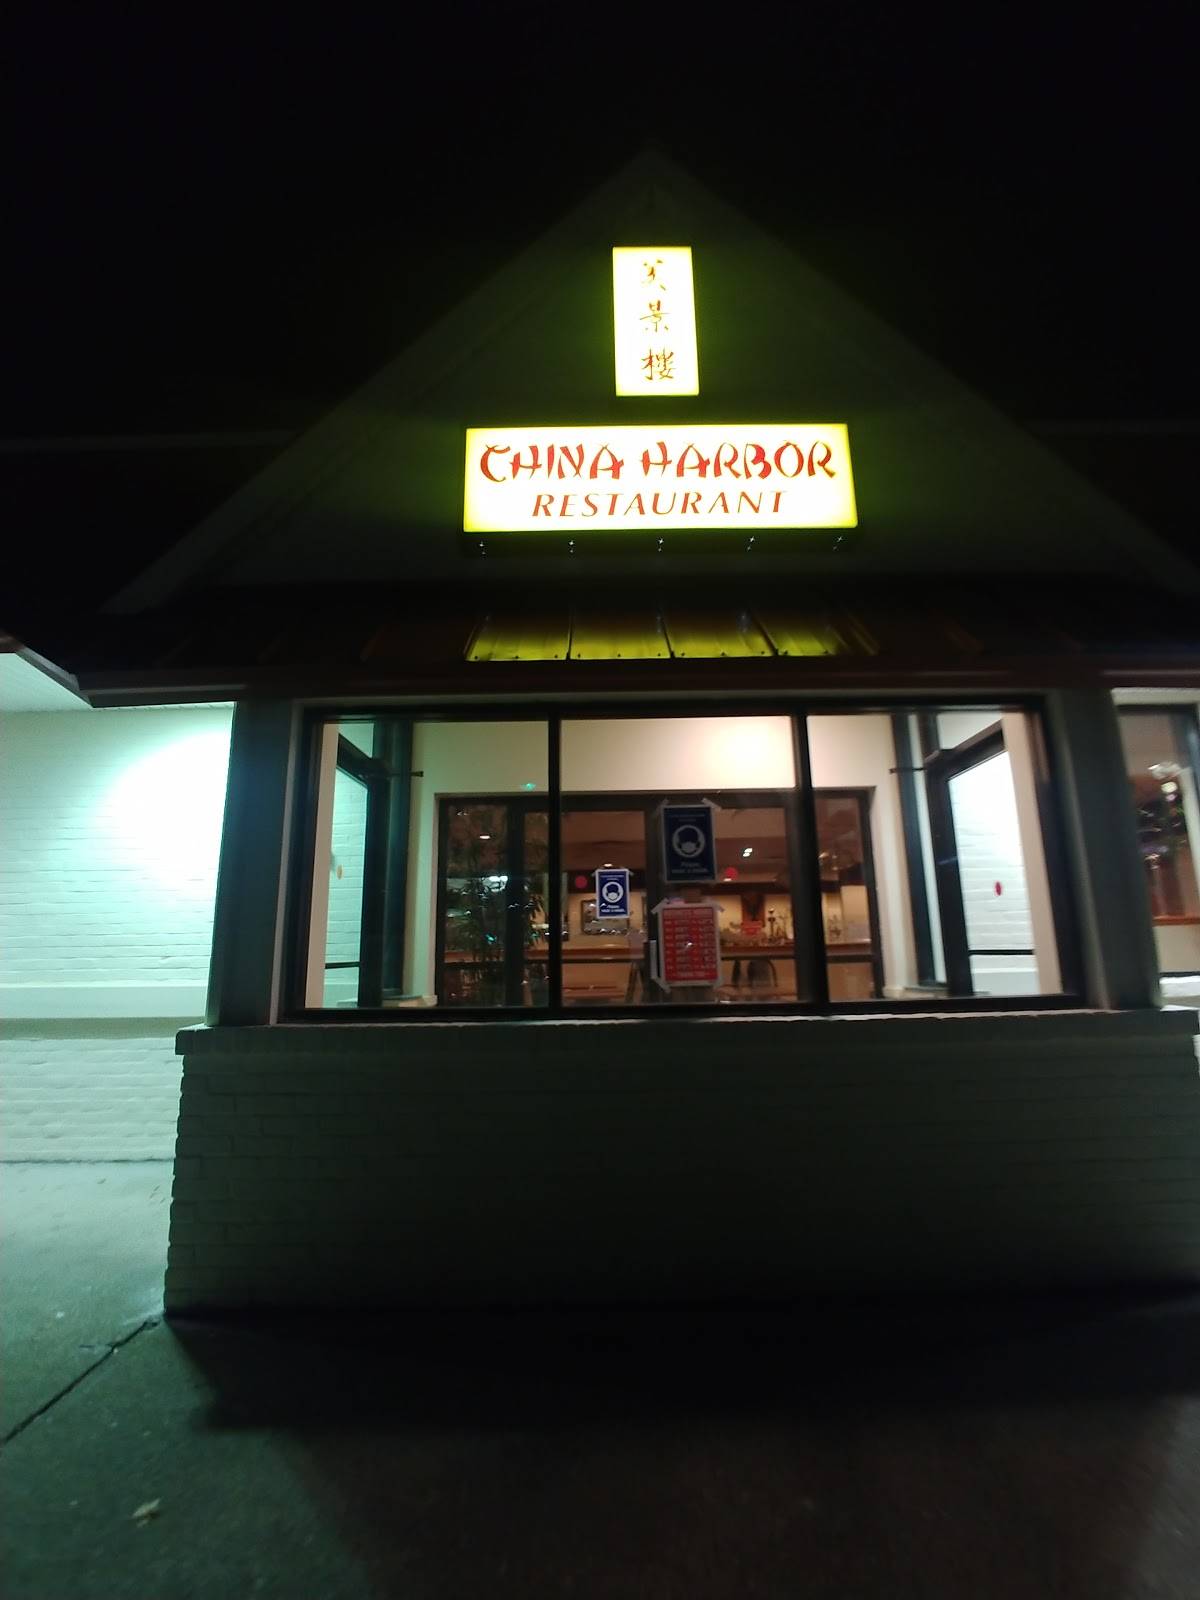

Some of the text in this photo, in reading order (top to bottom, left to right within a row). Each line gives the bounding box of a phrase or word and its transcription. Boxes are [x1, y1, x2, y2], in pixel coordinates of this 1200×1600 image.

[479, 439, 837, 483] CHINA HARBOR
[532, 490, 787, 518] RESTAURANT
